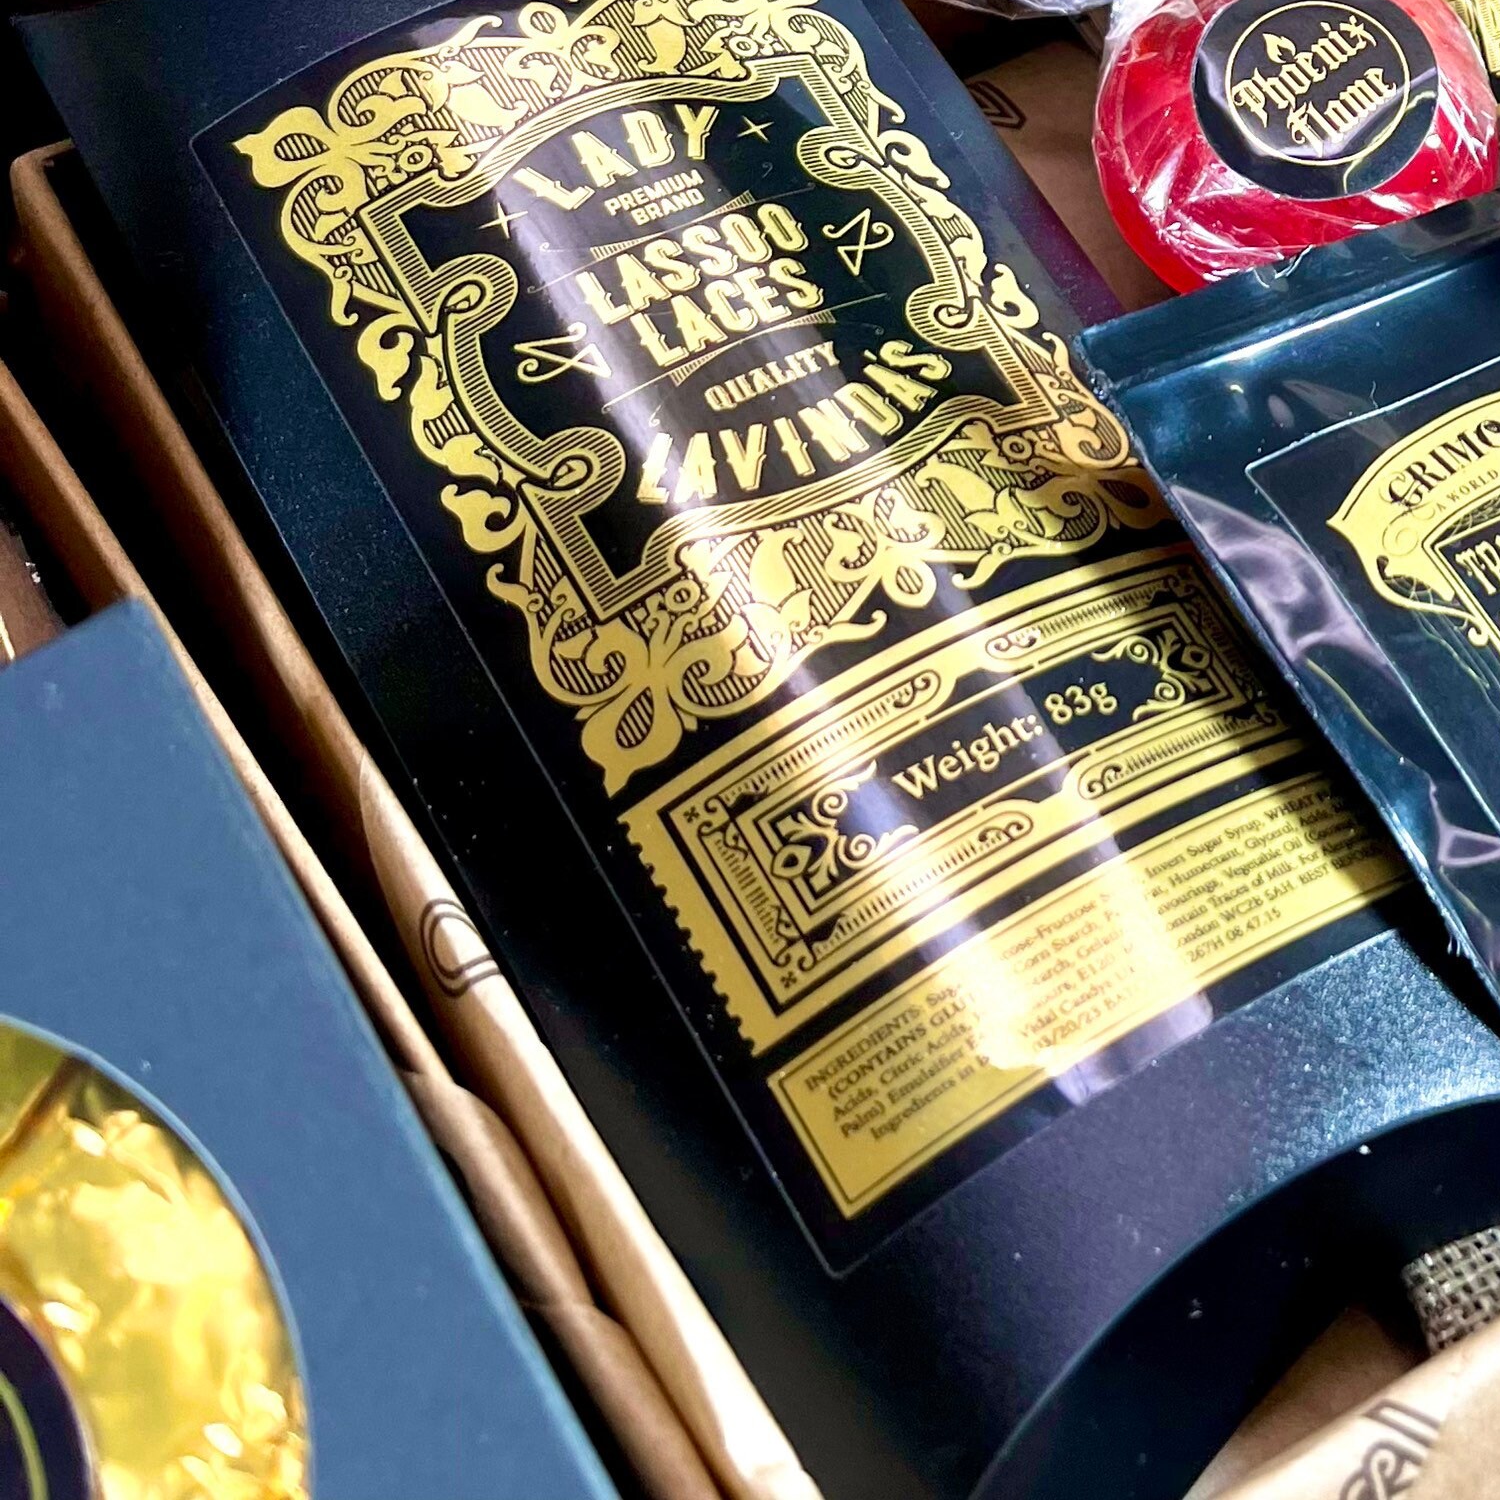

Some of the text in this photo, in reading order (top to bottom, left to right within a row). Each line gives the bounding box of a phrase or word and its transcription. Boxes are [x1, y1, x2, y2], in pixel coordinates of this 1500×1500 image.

[1231, 15, 1377, 129] Phoenix
[1286, 67, 1397, 159] Flame
[513, 103, 721, 211] LADY
[604, 168, 706, 218] PREMIUM
[631, 188, 706, 226] BRAND
[575, 202, 809, 325] LASSOO
[630, 256, 825, 368] LACES
[703, 340, 841, 412] QUALITY
[1445, 469, 1500, 504] WORLD
[893, 677, 1119, 800] Weight: 83g
[1186, 833, 1225, 861] Sugar
